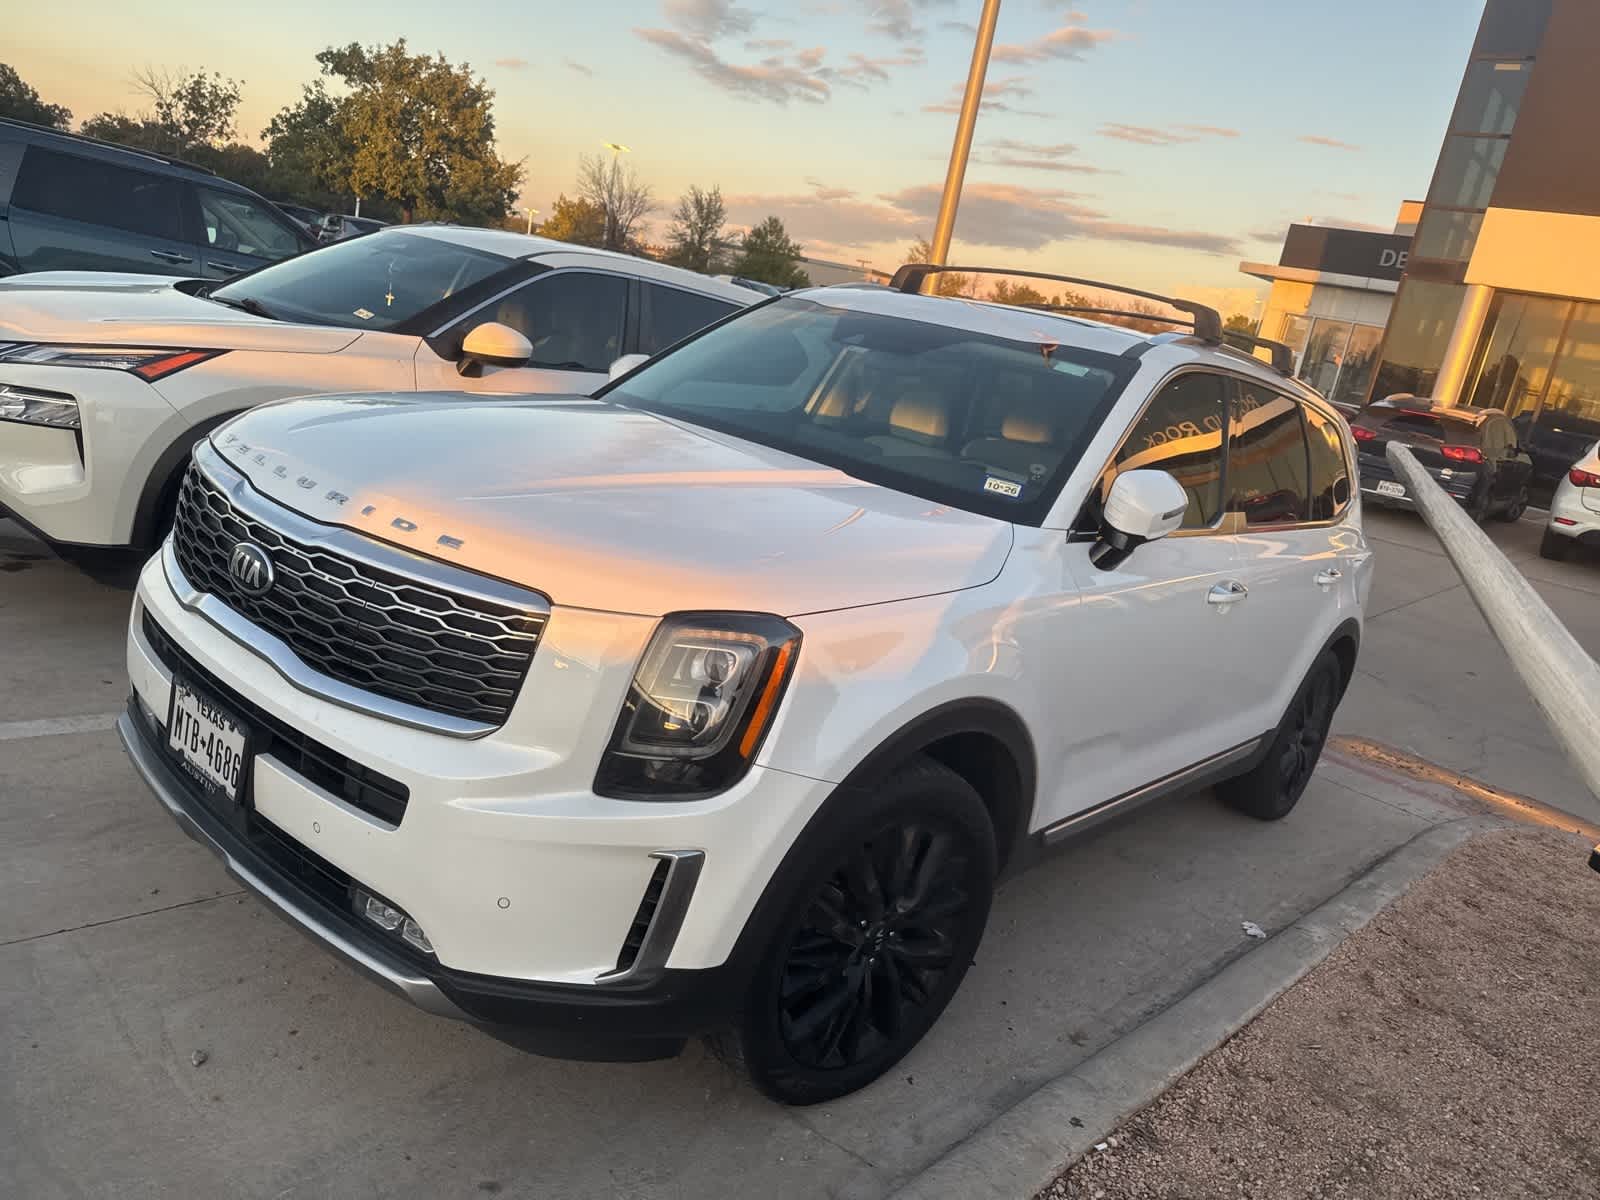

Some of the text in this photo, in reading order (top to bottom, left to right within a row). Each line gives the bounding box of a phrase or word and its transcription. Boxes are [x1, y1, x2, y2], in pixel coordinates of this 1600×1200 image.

[225, 433, 464, 549] TELLURIDE
[230, 549, 261, 588] KIA
[196, 698, 225, 731] TEXAS
